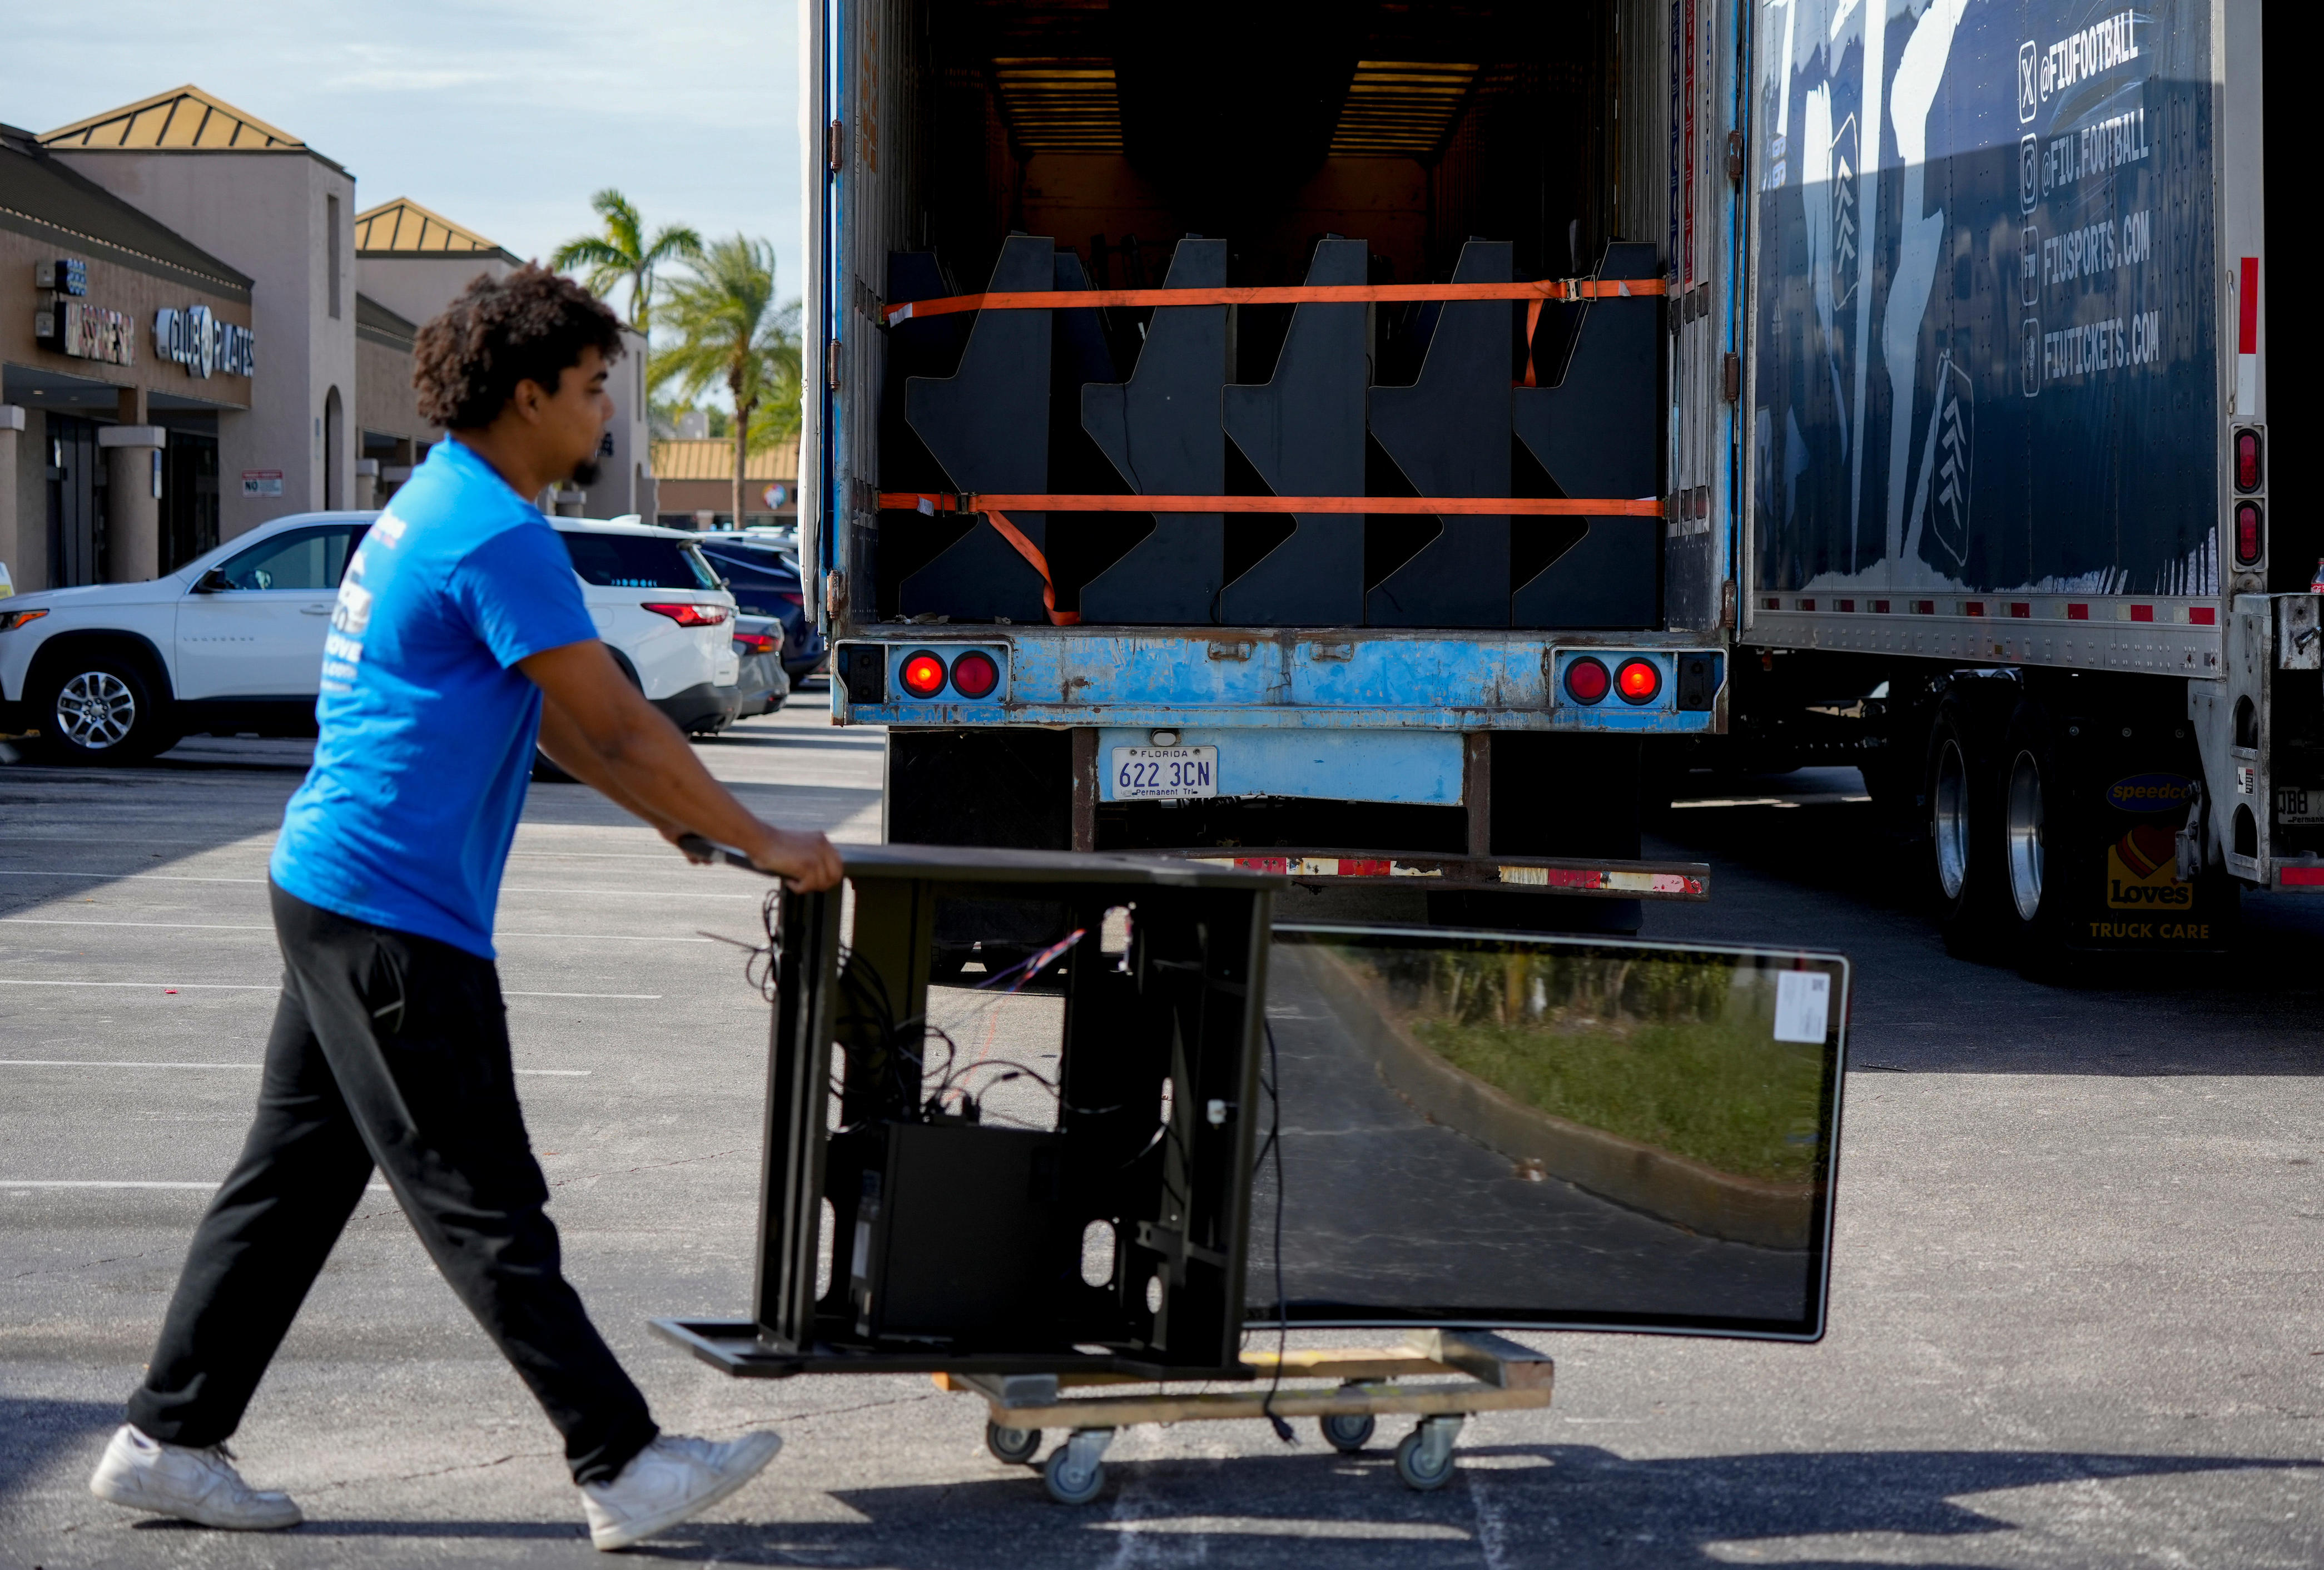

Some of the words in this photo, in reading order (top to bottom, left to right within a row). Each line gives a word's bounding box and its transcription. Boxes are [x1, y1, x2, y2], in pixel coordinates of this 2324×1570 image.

[2040, 9, 2138, 102] @FIUFOOTBALL
[2042, 108, 2148, 197] @FIU.FOOTBALL
[2044, 210, 2149, 286] FIUSPORTS.COM
[170, 309, 201, 365] CLUB
[2044, 310, 2159, 380] FIUTICKETS.COM
[245, 481, 258, 492] NO
[325, 635, 363, 662] OVE
[1120, 762, 1159, 788] 622
[1170, 761, 1209, 786] 3CN
[2090, 923, 2153, 938] TRUCK
[2160, 923, 2209, 939] CARE
